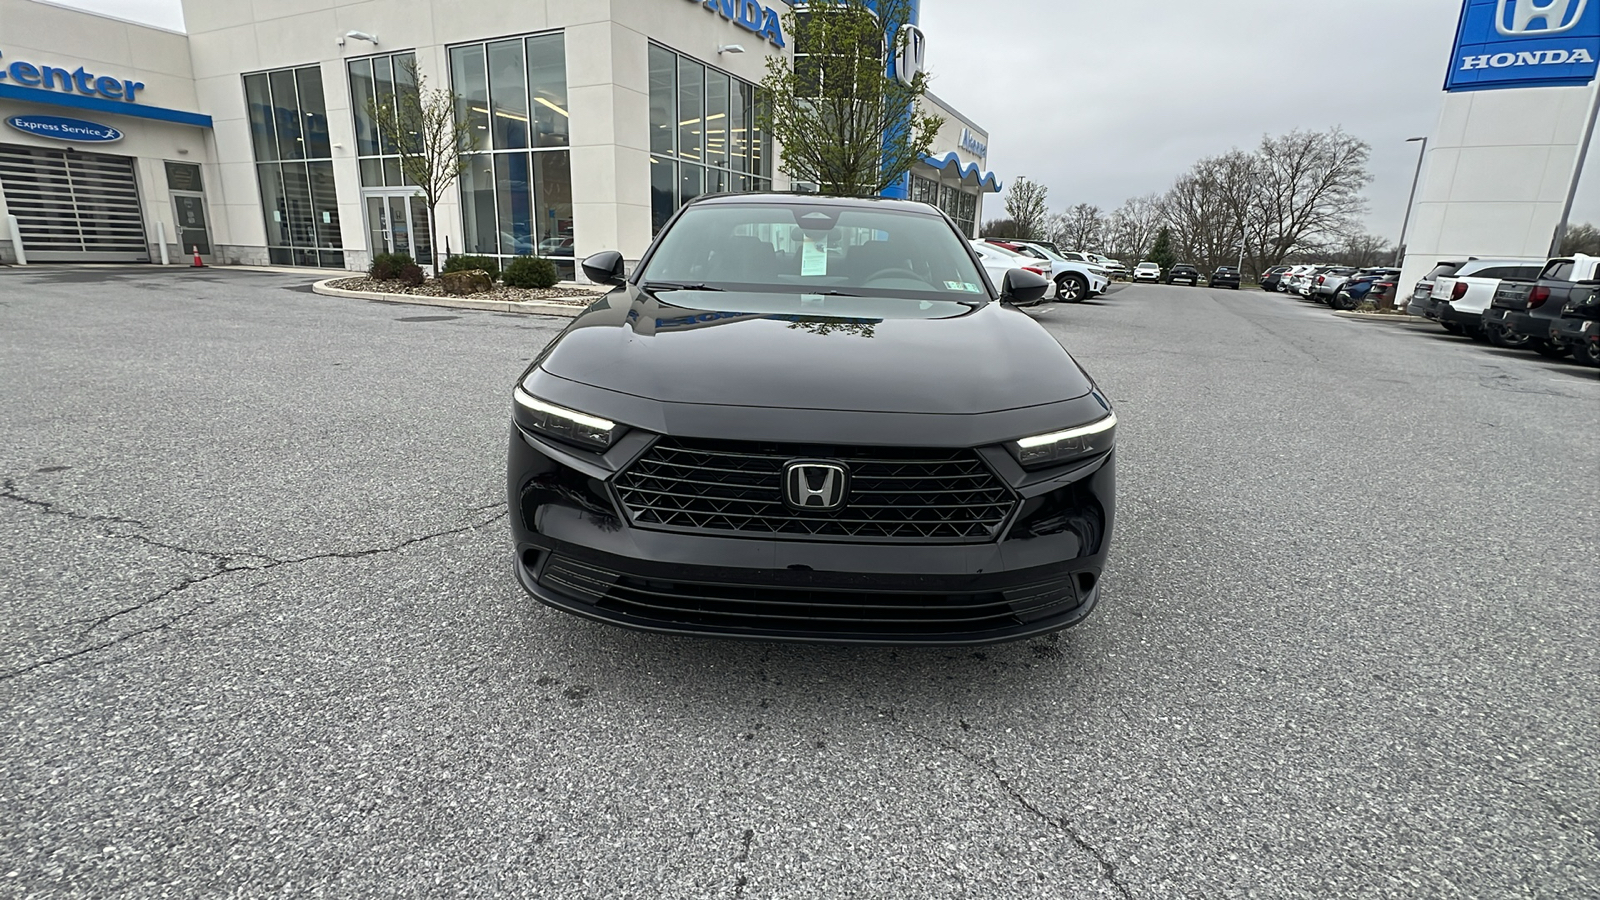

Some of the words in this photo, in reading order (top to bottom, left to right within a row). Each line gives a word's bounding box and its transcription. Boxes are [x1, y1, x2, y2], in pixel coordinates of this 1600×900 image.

[1460, 48, 1594, 70] HONDA
[14, 118, 59, 132] Express
[61, 124, 101, 136] Service
